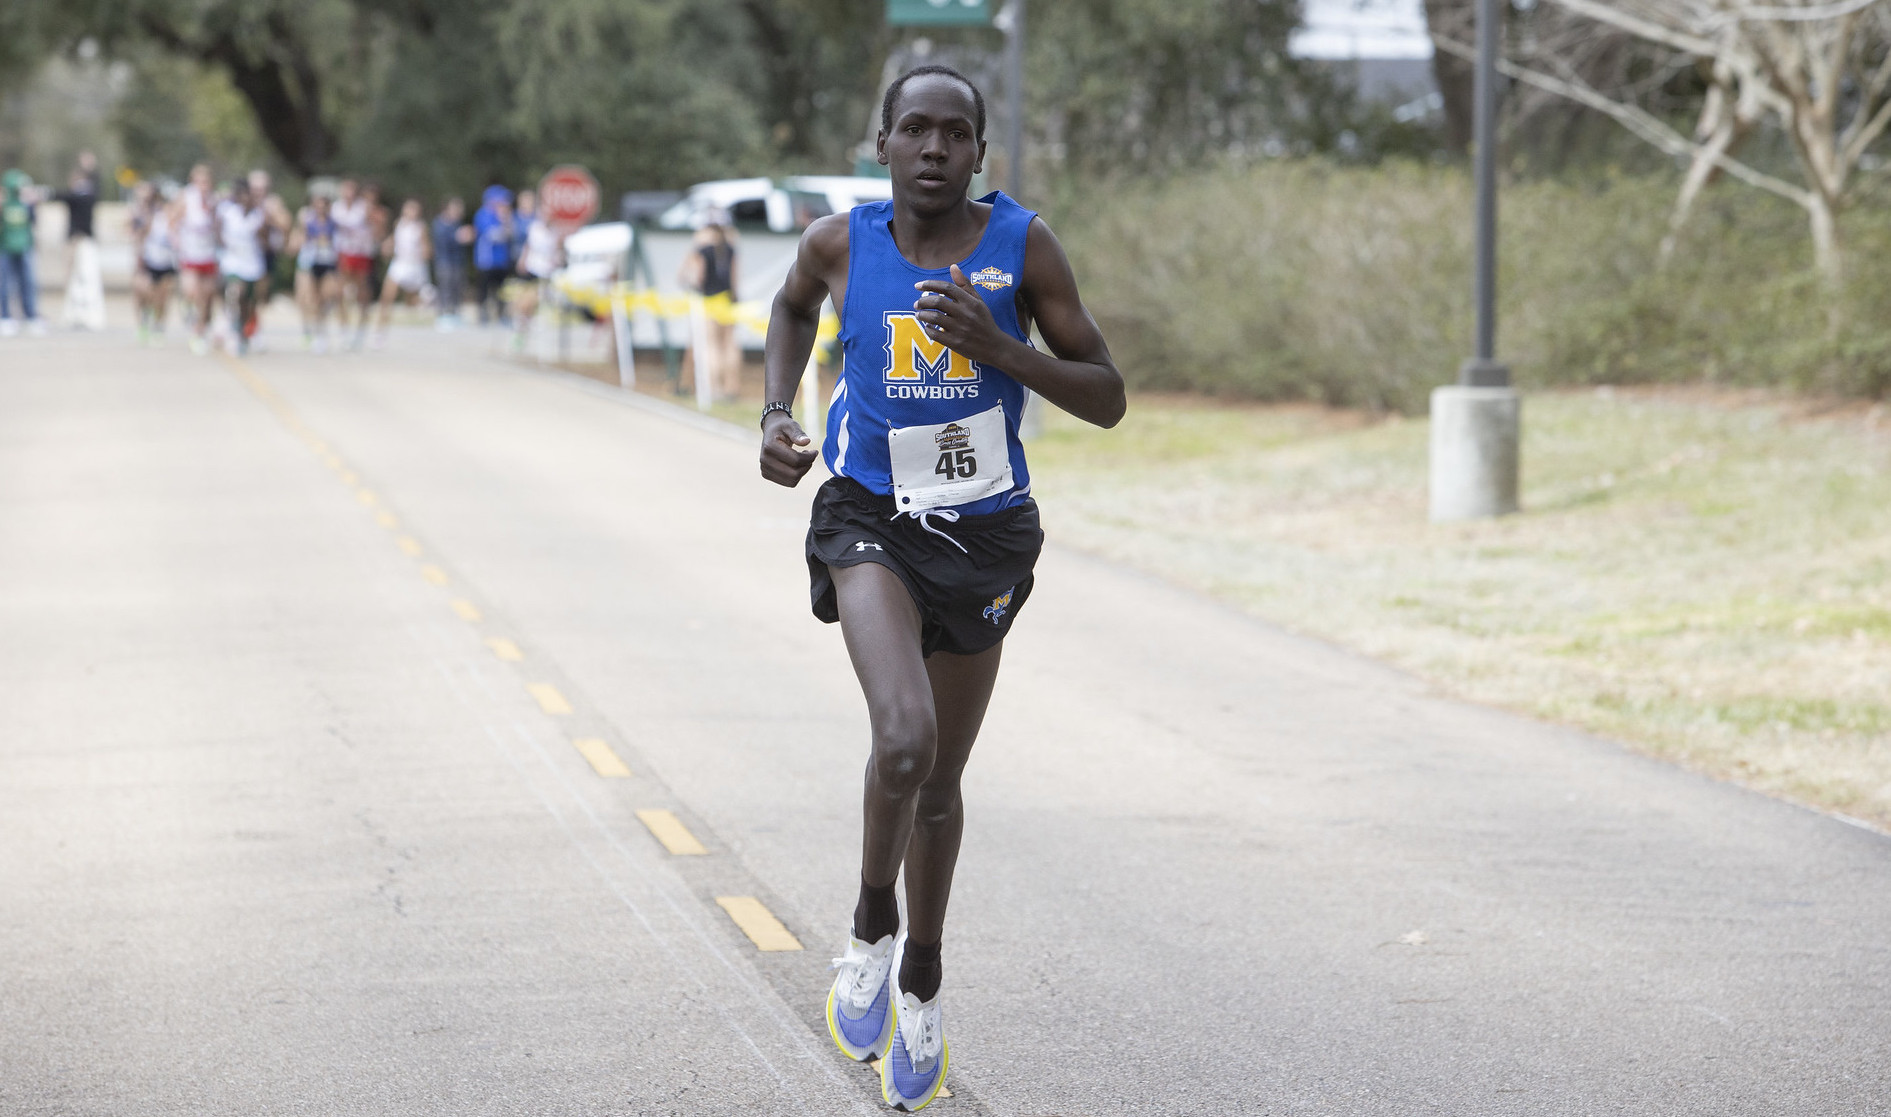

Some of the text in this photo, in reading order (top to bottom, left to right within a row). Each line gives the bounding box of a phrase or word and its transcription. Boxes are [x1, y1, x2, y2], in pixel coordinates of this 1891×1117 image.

[972, 273, 1012, 285] SOUTHLAND
[882, 310, 982, 384] M
[886, 385, 979, 399] COWBOYS
[762, 402, 792, 417] ENYA
[935, 448, 977, 480] 45
[993, 593, 1011, 610] M
